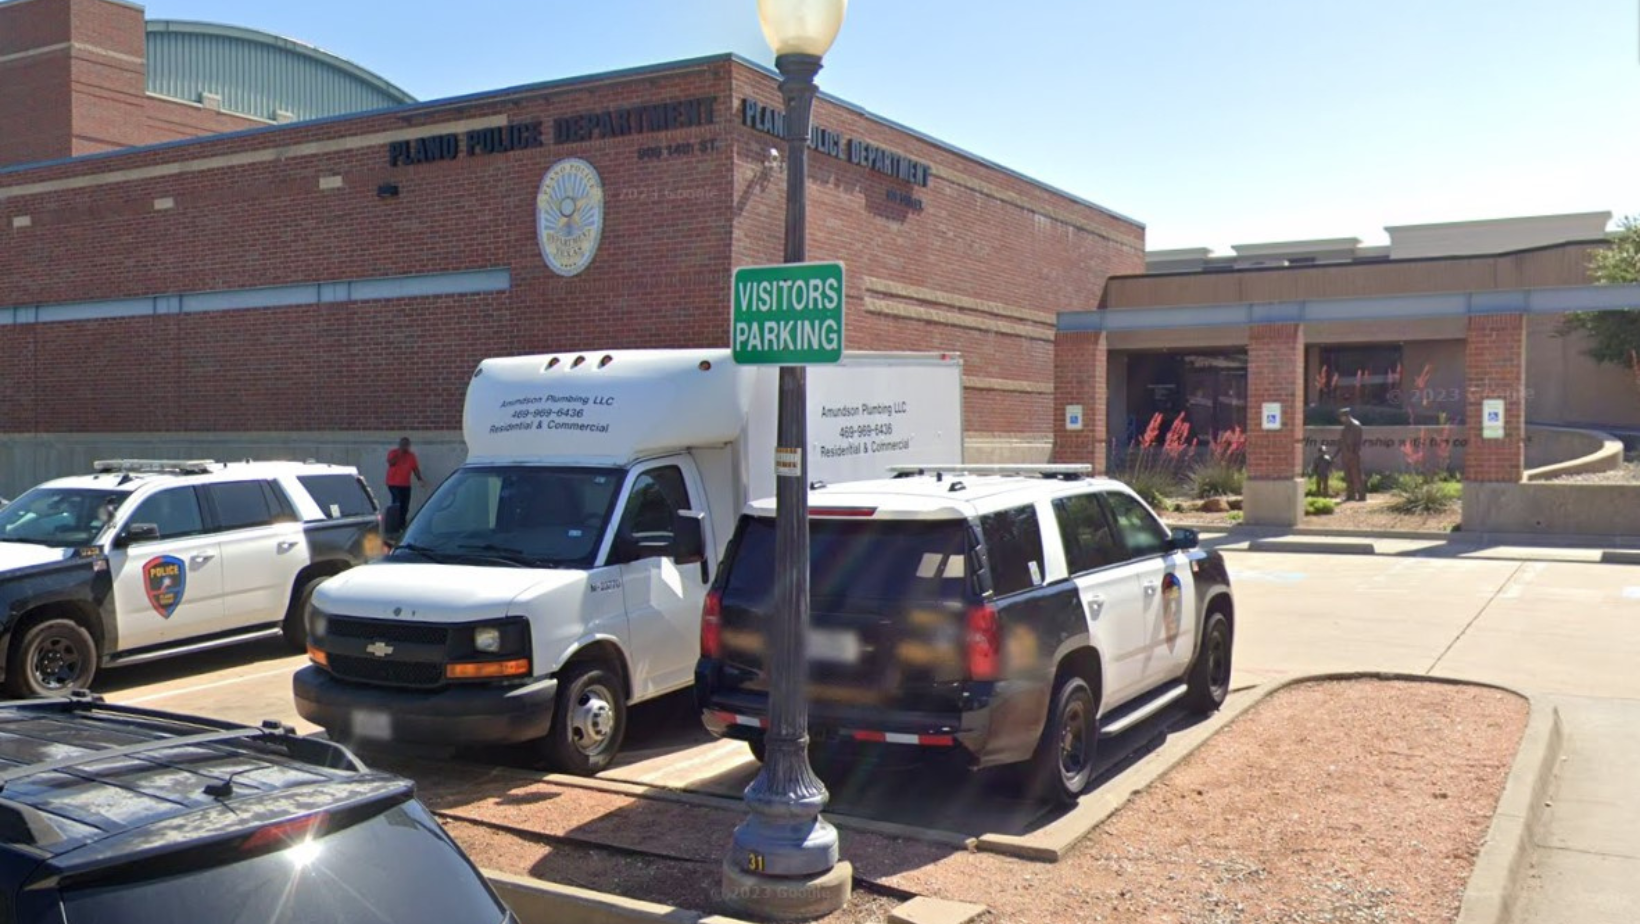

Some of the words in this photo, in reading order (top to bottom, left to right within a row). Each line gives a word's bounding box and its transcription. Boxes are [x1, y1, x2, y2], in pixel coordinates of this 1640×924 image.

[389, 133, 459, 167] PLANO
[465, 121, 544, 157] POLICE
[553, 96, 717, 145] DEPARTMENT
[741, 98, 788, 141] PLAN
[848, 138, 930, 188] DEPARTMENT
[738, 278, 839, 312] VISITORS
[735, 318, 839, 352] PARKING
[500, 396, 543, 409] Amundson
[544, 394, 590, 406] Plumbing
[593, 396, 615, 406] LLC
[820, 404, 860, 418] Amundson
[861, 403, 893, 417] Plumbing
[894, 401, 907, 414] LLC
[510, 408, 584, 419] 469-969-6436
[489, 420, 534, 434] Residential
[535, 421, 543, 430] &
[547, 420, 610, 434] Commercial
[838, 422, 893, 438] 469-969-6436
[820, 442, 861, 459] Residential
[863, 442, 869, 454] &
[871, 438, 910, 454] Commercial
[150, 564, 179, 578] POLICE
[748, 854, 764, 872] 31
